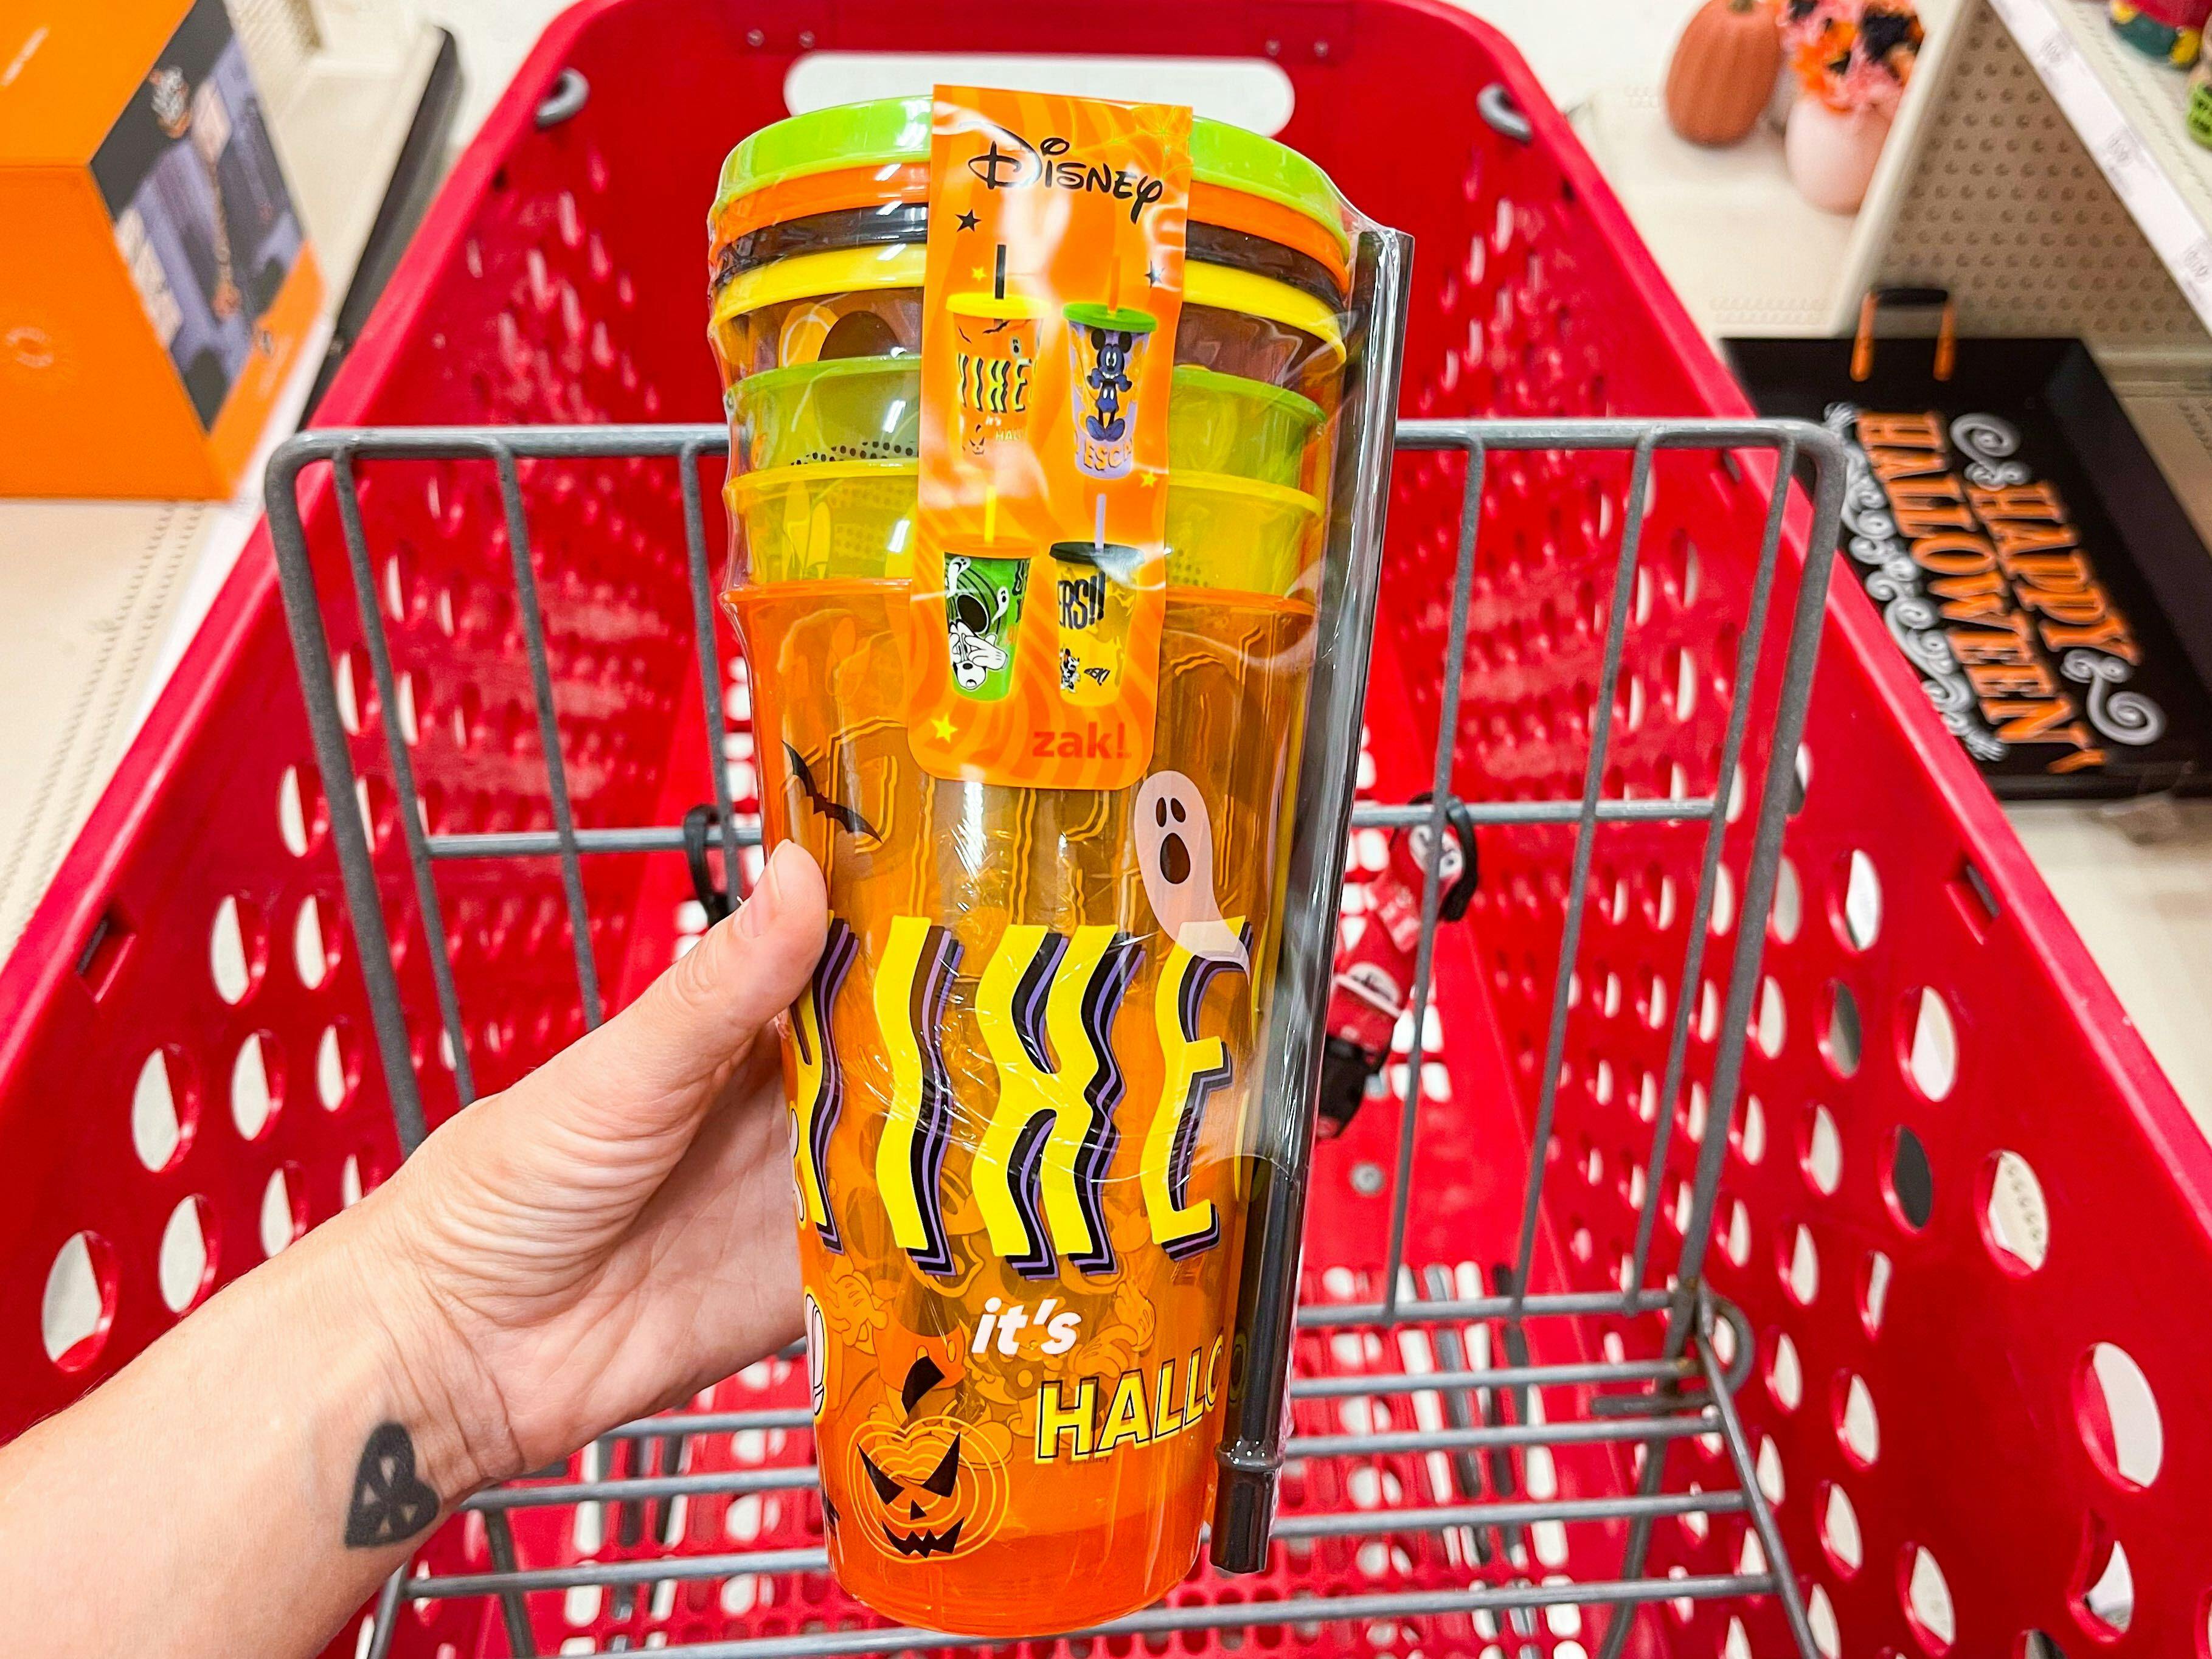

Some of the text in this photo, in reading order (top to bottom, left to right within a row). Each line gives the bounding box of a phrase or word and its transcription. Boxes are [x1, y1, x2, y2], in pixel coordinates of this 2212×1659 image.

[1965, 480, 2143, 667] HAPPY
[1032, 721, 1125, 760] zak!
[971, 1297, 1083, 1356] it's
